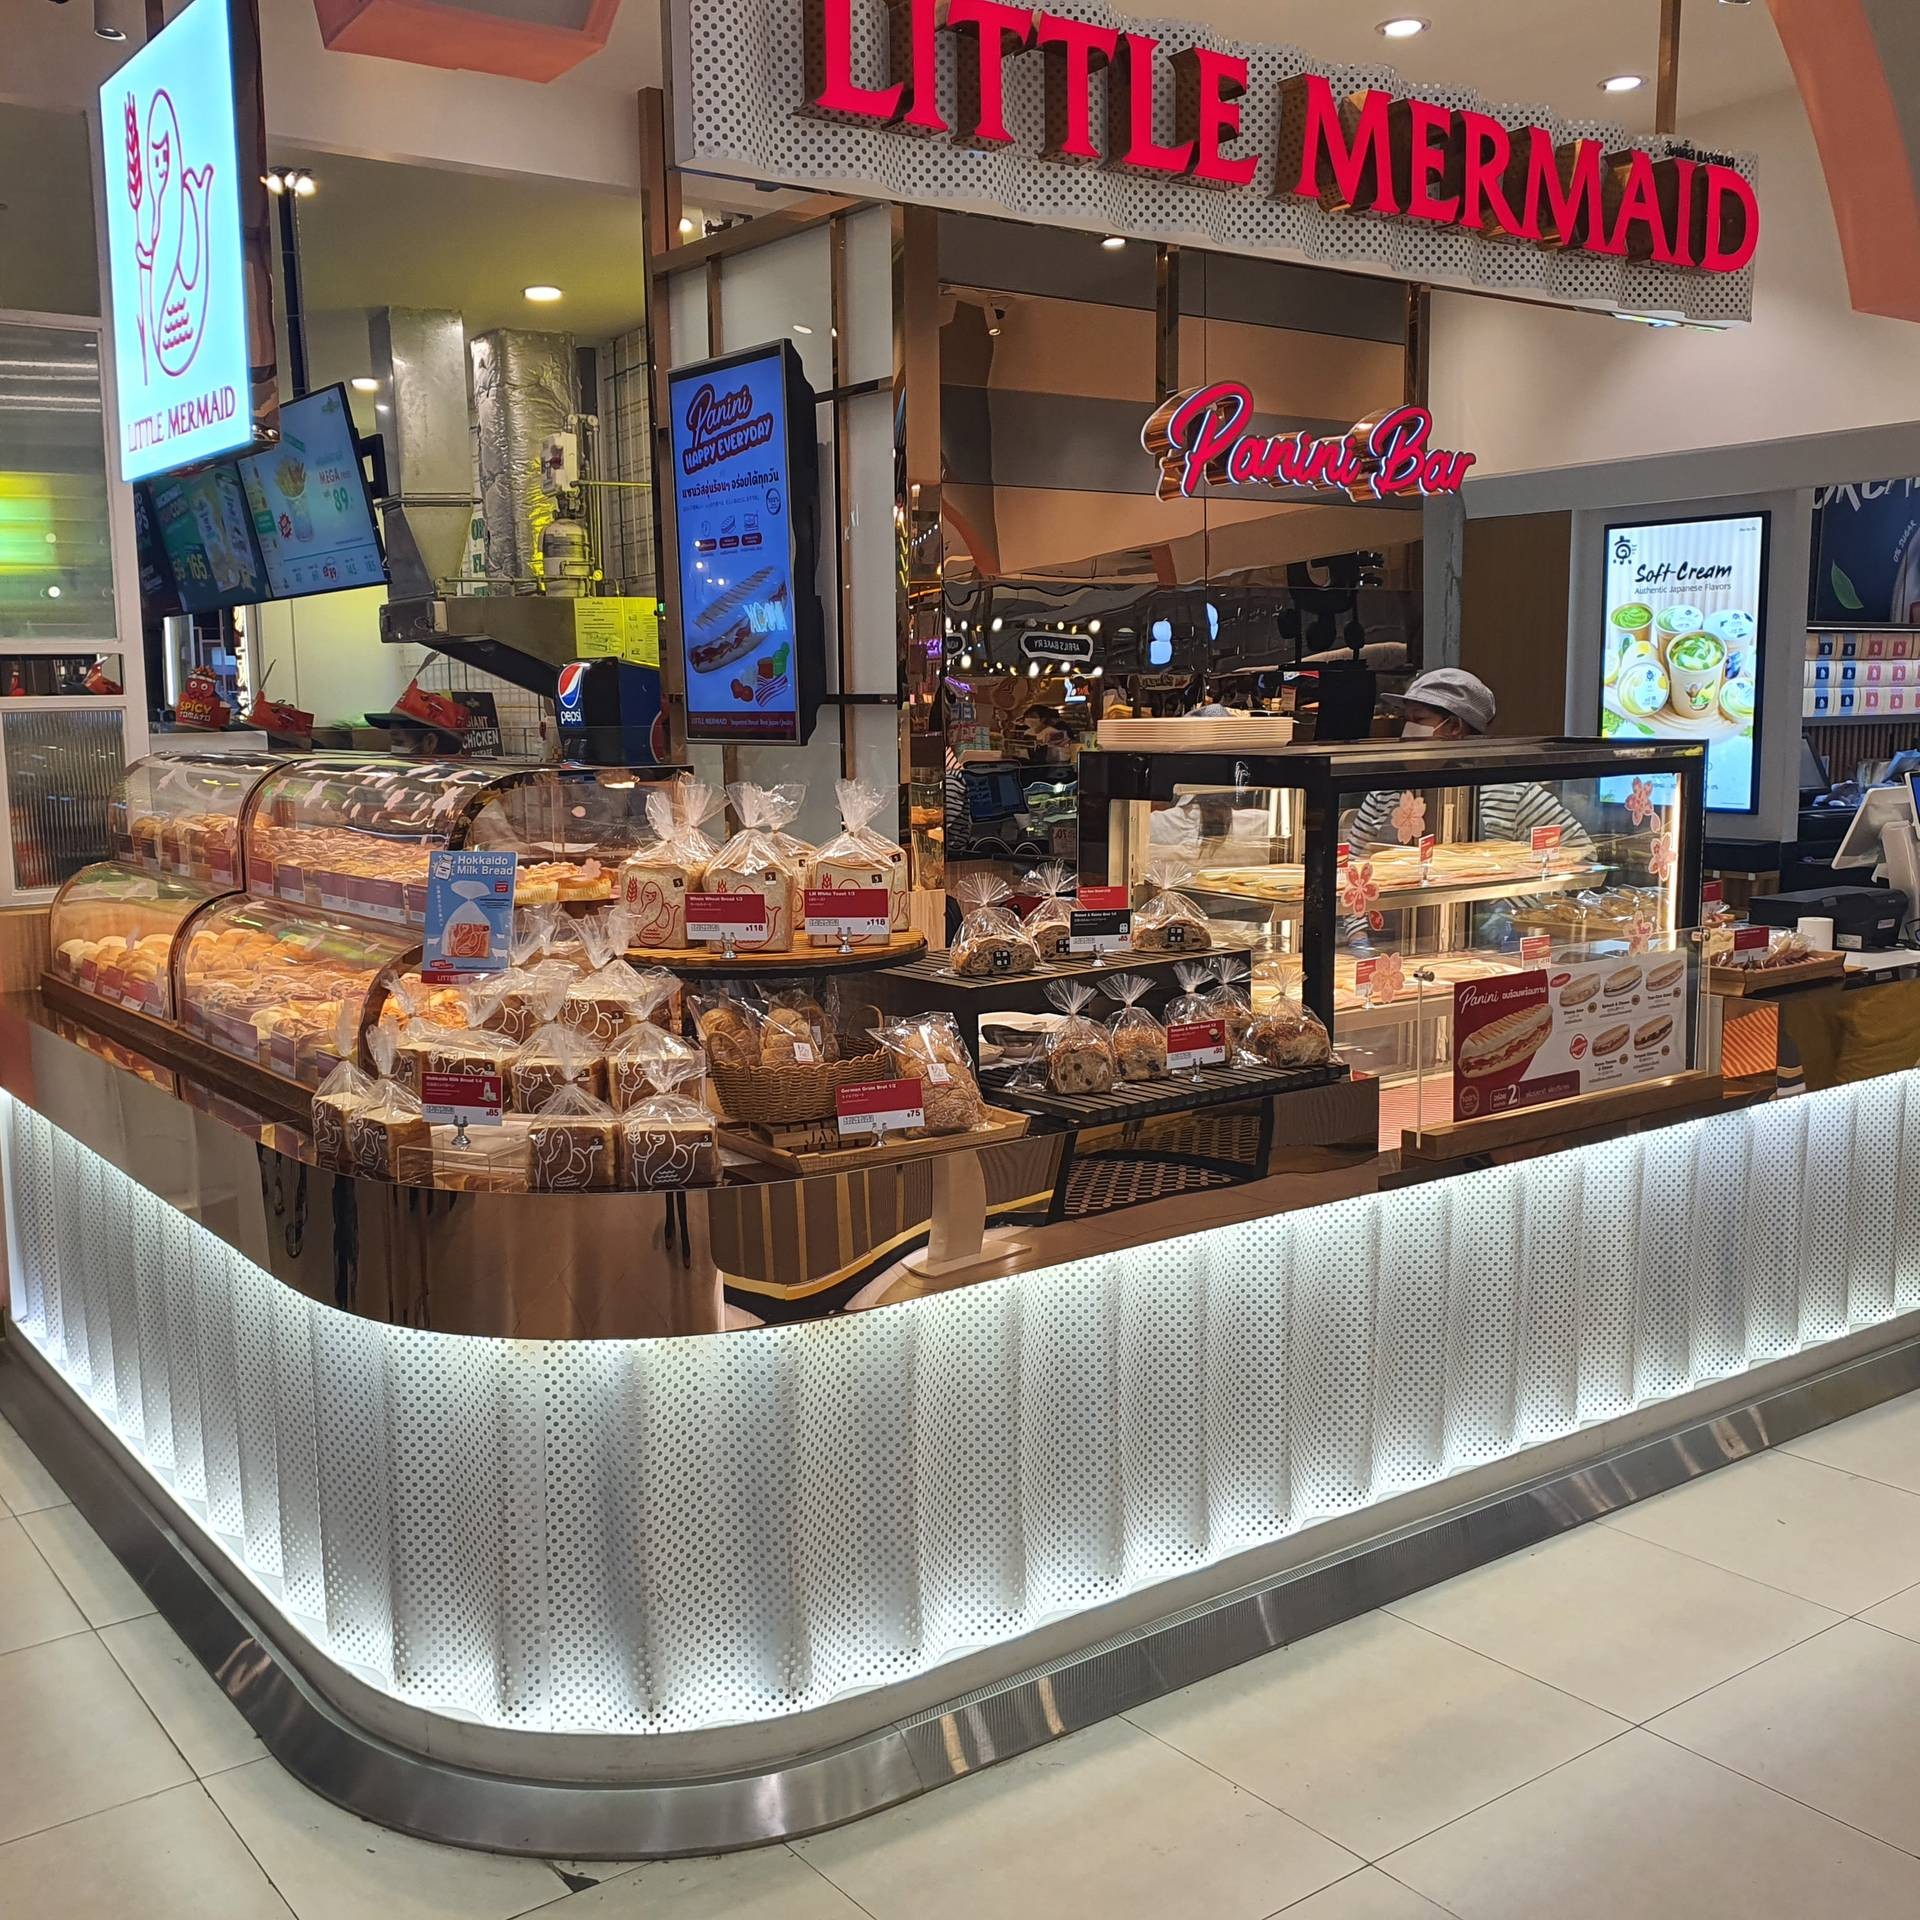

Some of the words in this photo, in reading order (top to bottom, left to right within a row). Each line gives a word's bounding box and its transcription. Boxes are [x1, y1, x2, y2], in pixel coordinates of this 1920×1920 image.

[815, 0, 1259, 186] LITTLE
[1294, 74, 1759, 273] MERMAID
[127, 411, 165, 452] LITTLE
[167, 385, 236, 440] MERMAID
[688, 388, 751, 449] Panini
[685, 443, 716, 469] HAPPY
[717, 418, 772, 456] EVERYDAY
[1166, 382, 1362, 498] Panini
[1369, 406, 1476, 500] Bar
[1898, 520, 1918, 546] SUGAR
[1635, 561, 1732, 584] Soft-Cream
[1634, 585, 1667, 595] Authentic
[1669, 584, 1703, 594] Japanese
[1704, 583, 1732, 592] Flavors
[180, 701, 212, 715] SPICY
[560, 709, 582, 724] pepsi
[457, 865, 479, 875] Milk
[481, 866, 514, 876] Bread
[458, 855, 508, 865] Hokkaido
[1458, 985, 1499, 1015] Panini
[841, 1086, 862, 1094] German
[1507, 1083, 1519, 1104] 2
